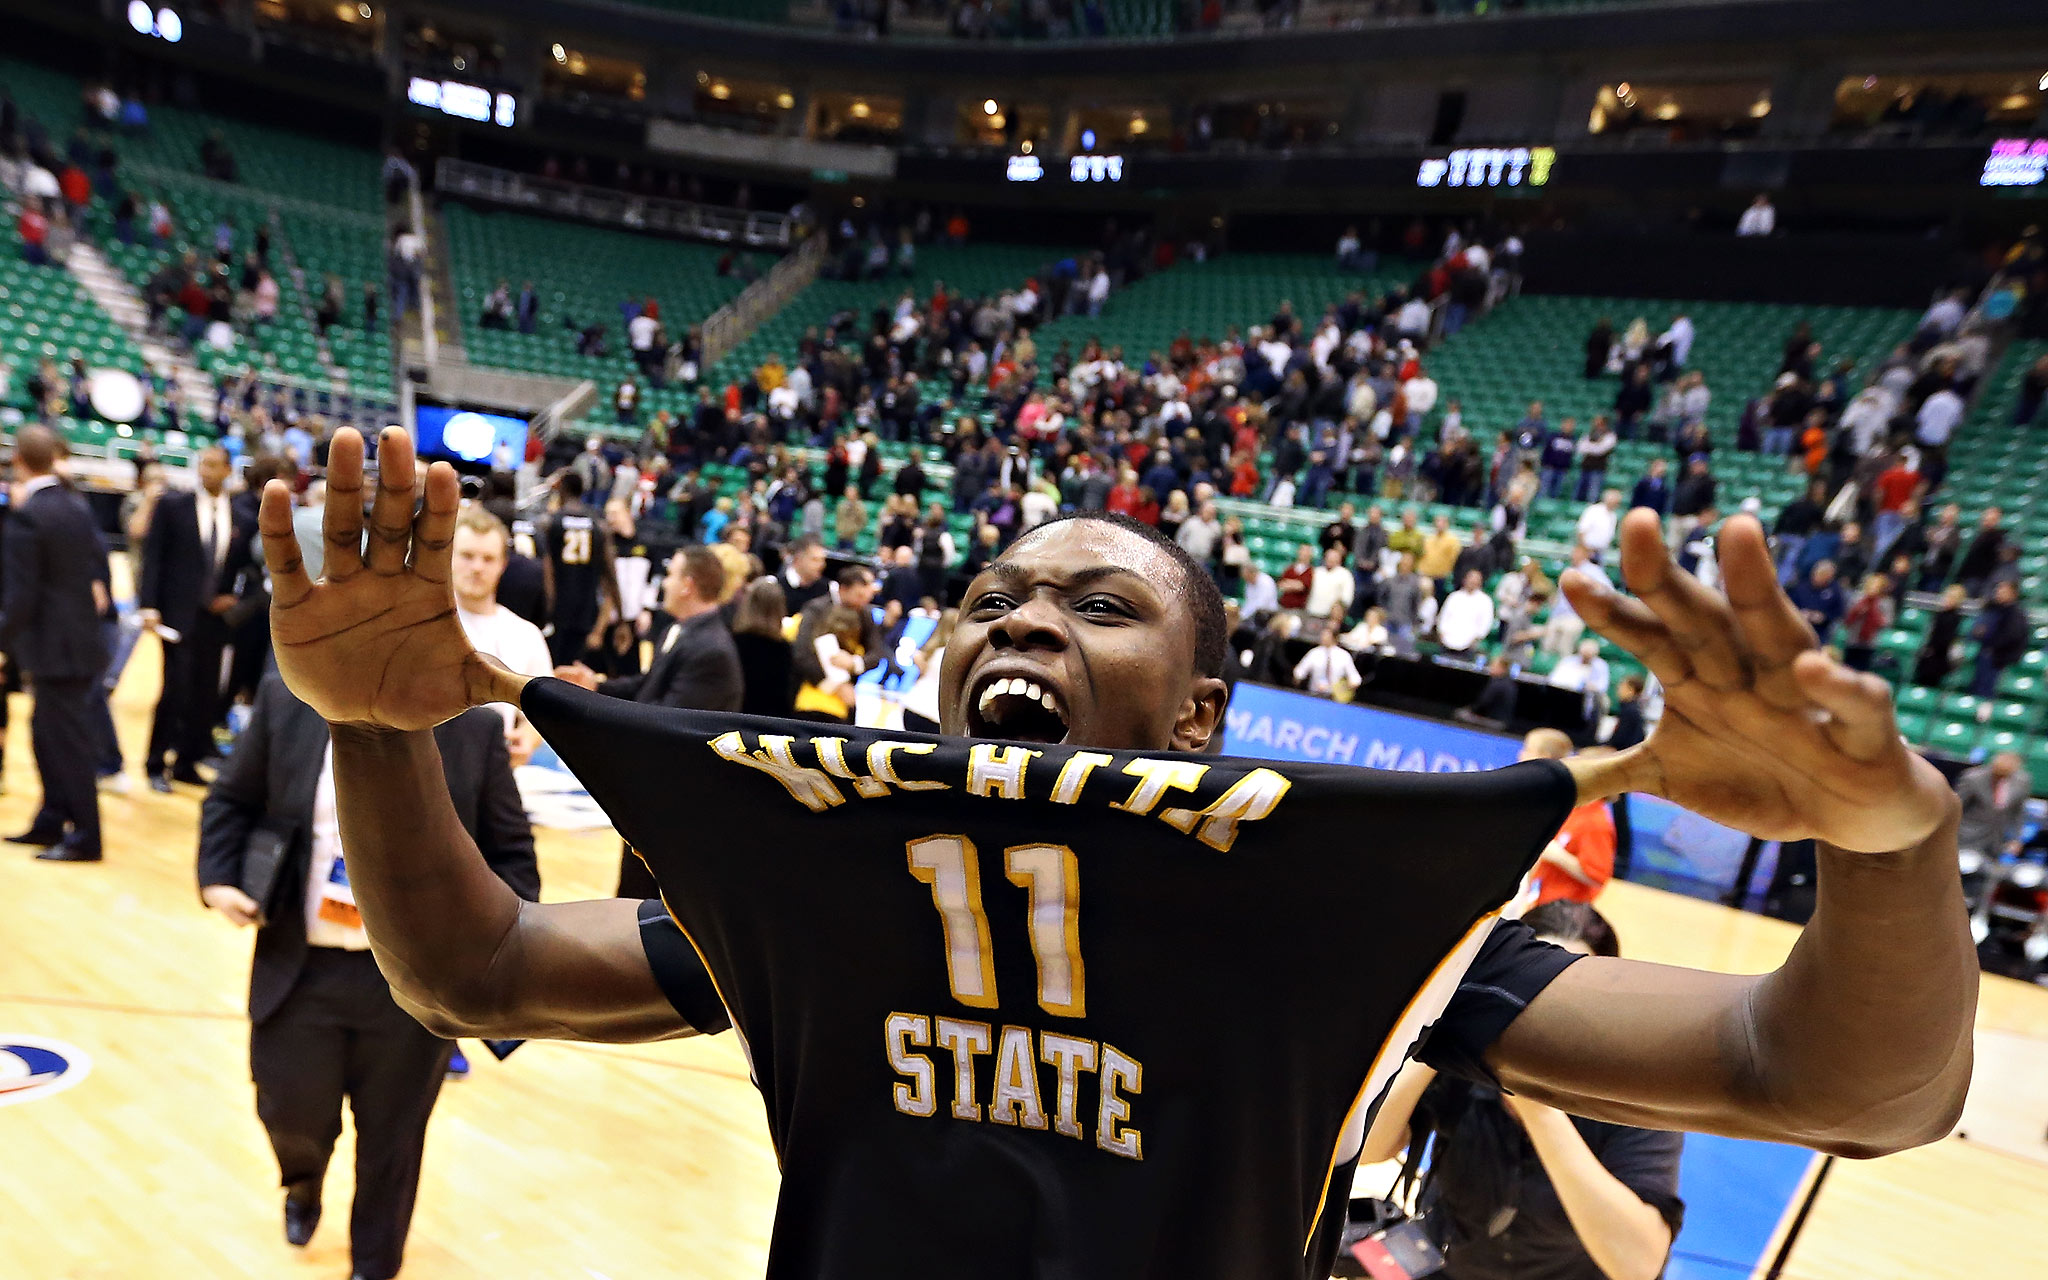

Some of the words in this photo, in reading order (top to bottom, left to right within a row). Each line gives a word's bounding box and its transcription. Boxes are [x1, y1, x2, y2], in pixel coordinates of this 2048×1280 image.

[561, 529, 592, 565] 21
[707, 731, 1292, 852] WICHITA
[1226, 707, 1359, 762] MARCH
[906, 833, 1086, 1018] 11
[885, 1011, 1143, 1160] STATE
